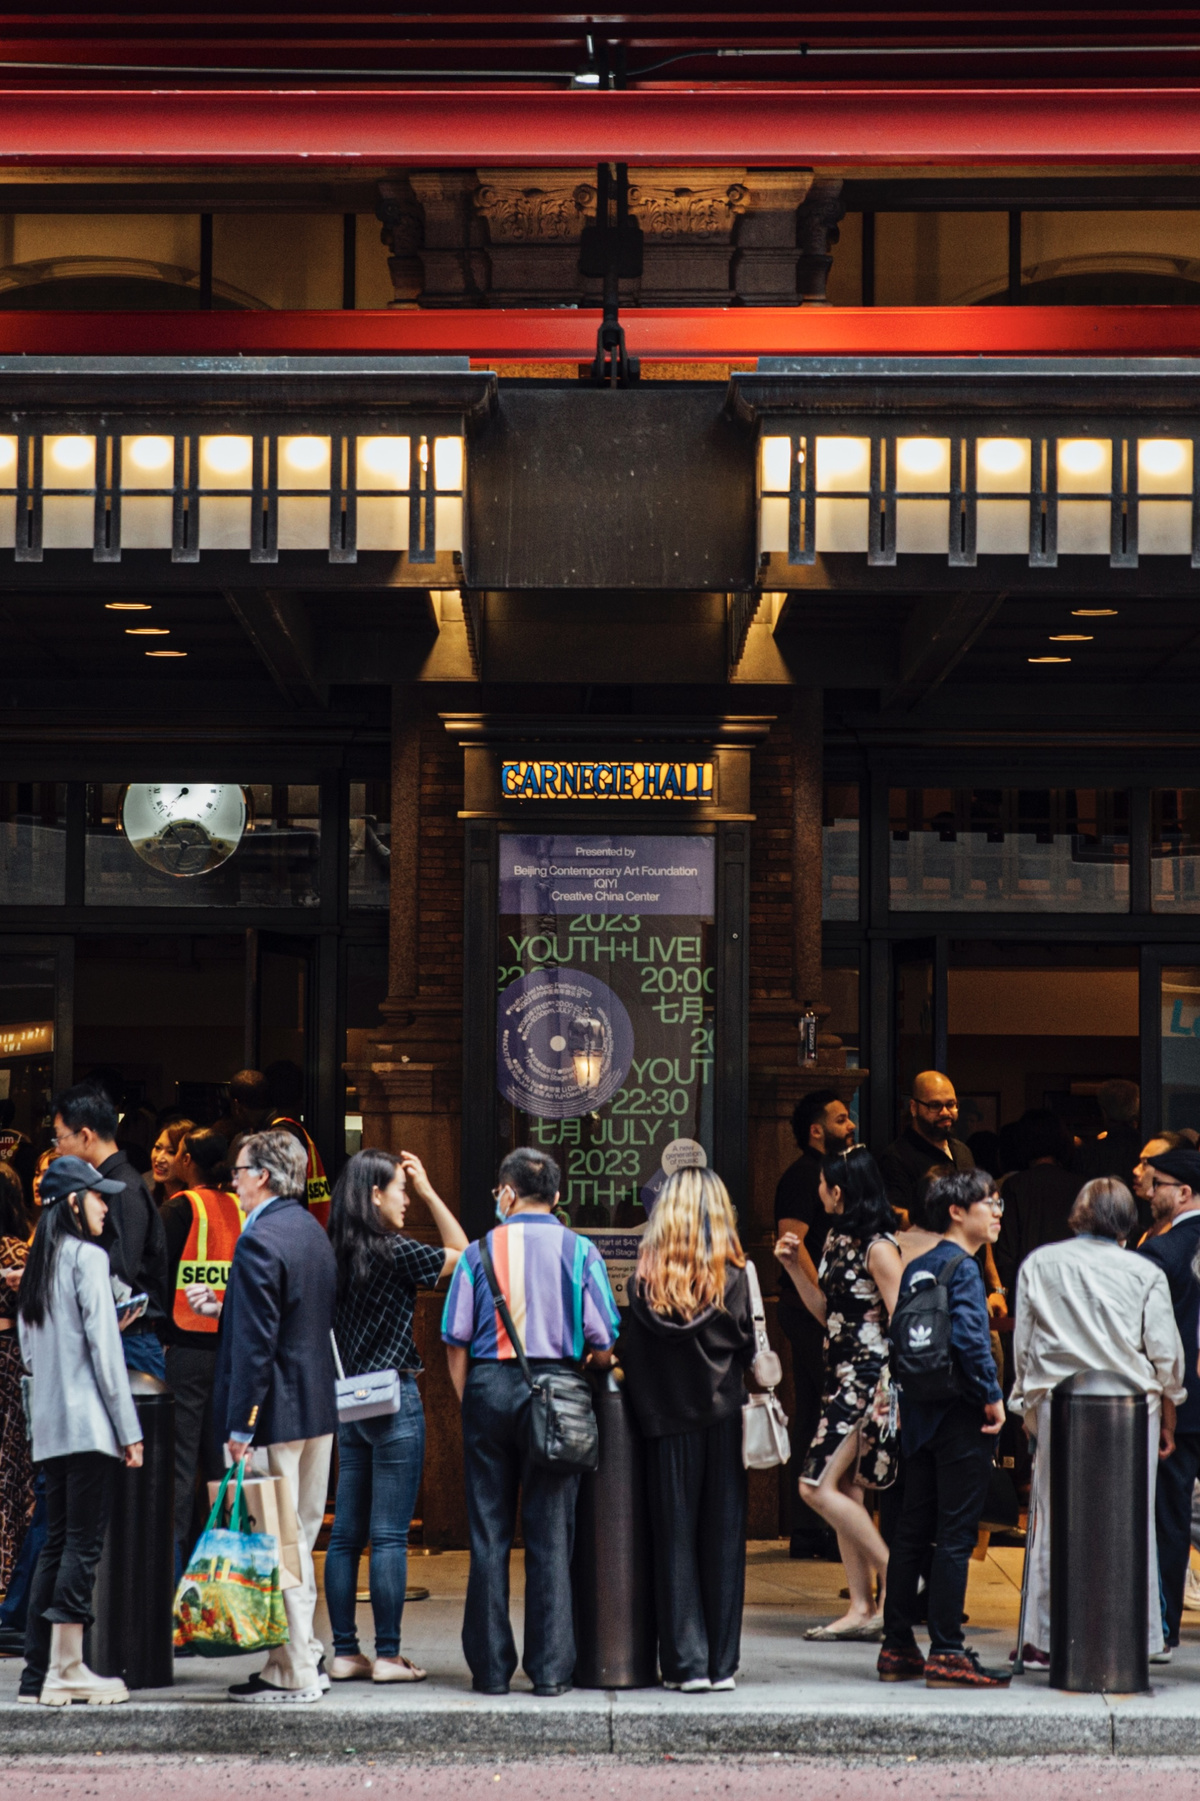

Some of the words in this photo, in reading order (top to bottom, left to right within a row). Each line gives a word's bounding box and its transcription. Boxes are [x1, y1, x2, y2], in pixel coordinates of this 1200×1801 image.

[502, 764, 634, 795] CARNEGIE
[644, 765, 713, 796] HALL
[576, 848, 622, 856] Presented
[624, 848, 636, 859] by
[514, 866, 547, 878] Beijing
[550, 866, 622, 878] Contemporary
[624, 866, 640, 876] Art
[642, 866, 698, 876] Foundation
[552, 892, 593, 902] Creative
[595, 892, 624, 902] China
[626, 892, 660, 902] Center
[570, 914, 641, 932] 2023
[508, 936, 702, 962] YOUTH+LIVE!
[652, 996, 703, 1024] 七月
[530, 1118, 580, 1145] 七月
[590, 1119, 662, 1145] JULY
[668, 1120, 680, 1140] 1
[568, 1149, 640, 1176] 2023
[666, 1151, 702, 1160] generation
[623, 1238, 638, 1246] $43
[182, 1267, 232, 1284] SECU
